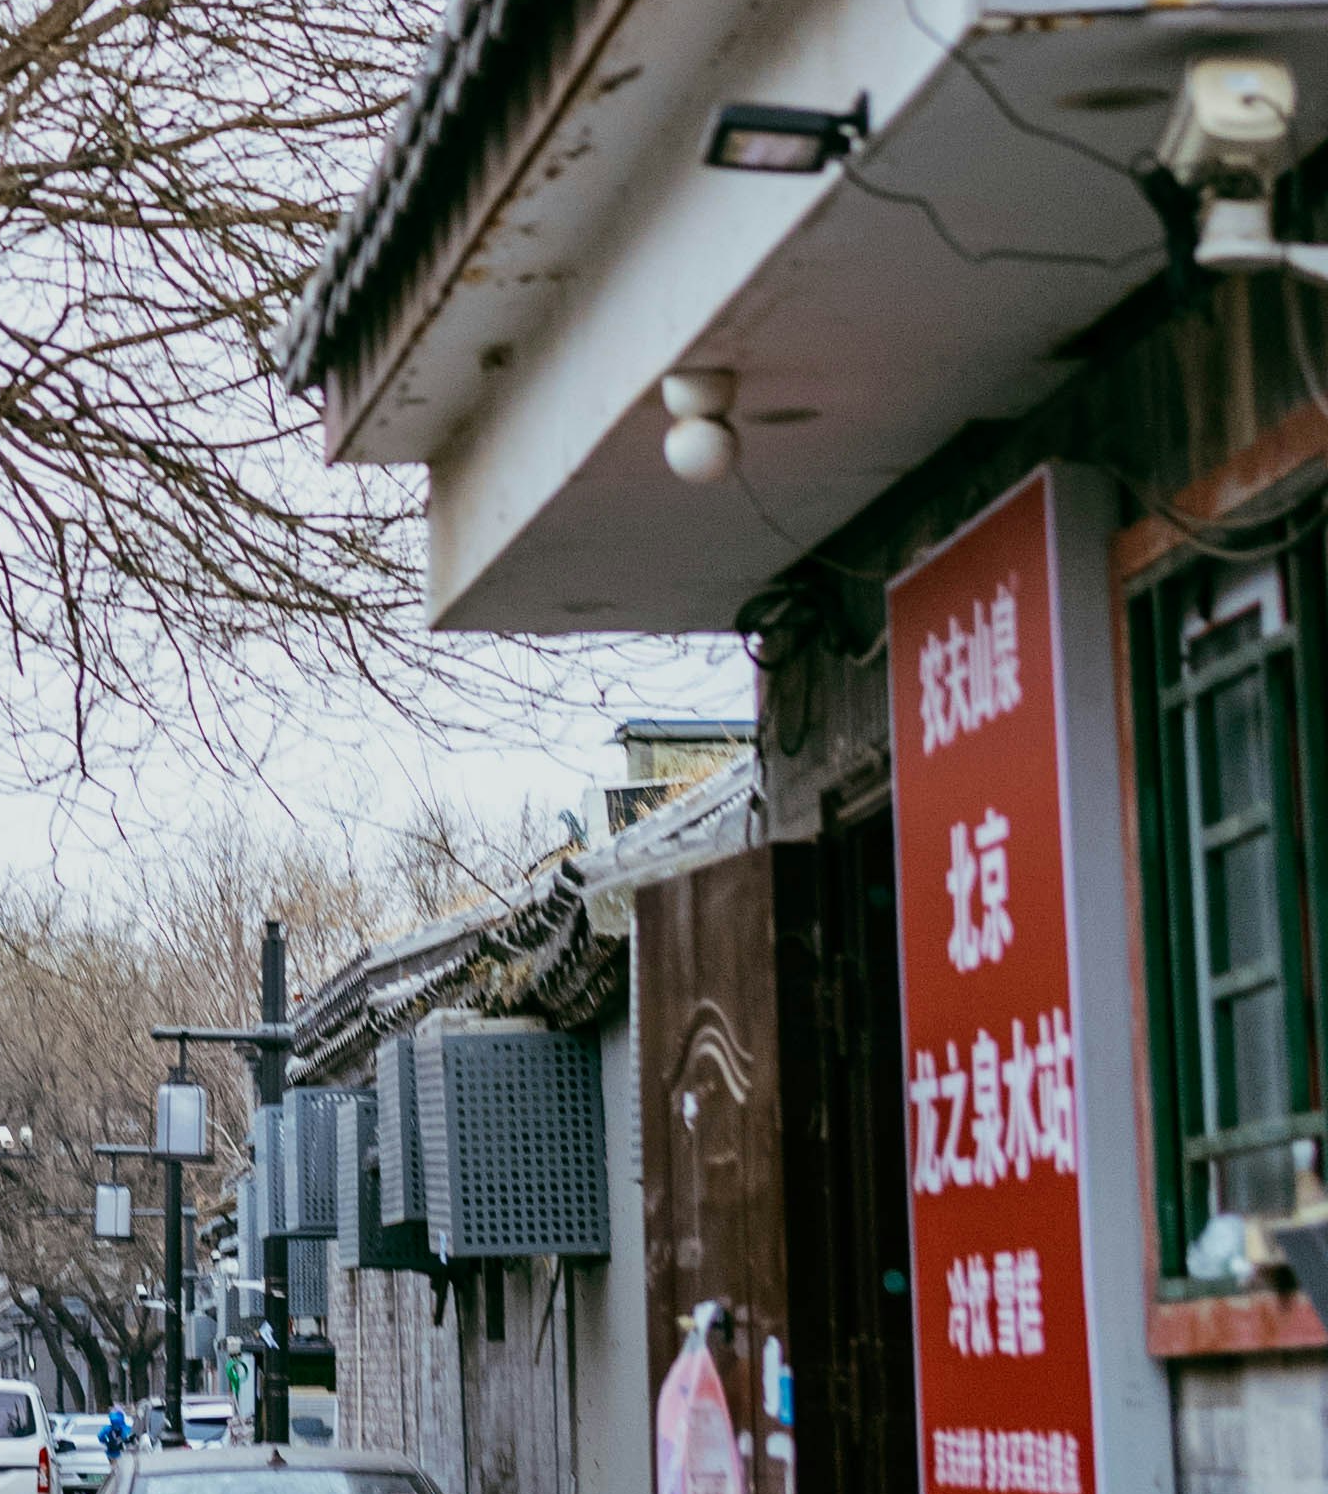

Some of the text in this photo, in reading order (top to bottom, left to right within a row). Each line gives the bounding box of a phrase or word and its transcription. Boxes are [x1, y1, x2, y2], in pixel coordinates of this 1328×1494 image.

[919, 583, 1023, 757] 农夫山泉
[945, 806, 1013, 974] 北京
[908, 1005, 1076, 1196] 龙之泉水站
